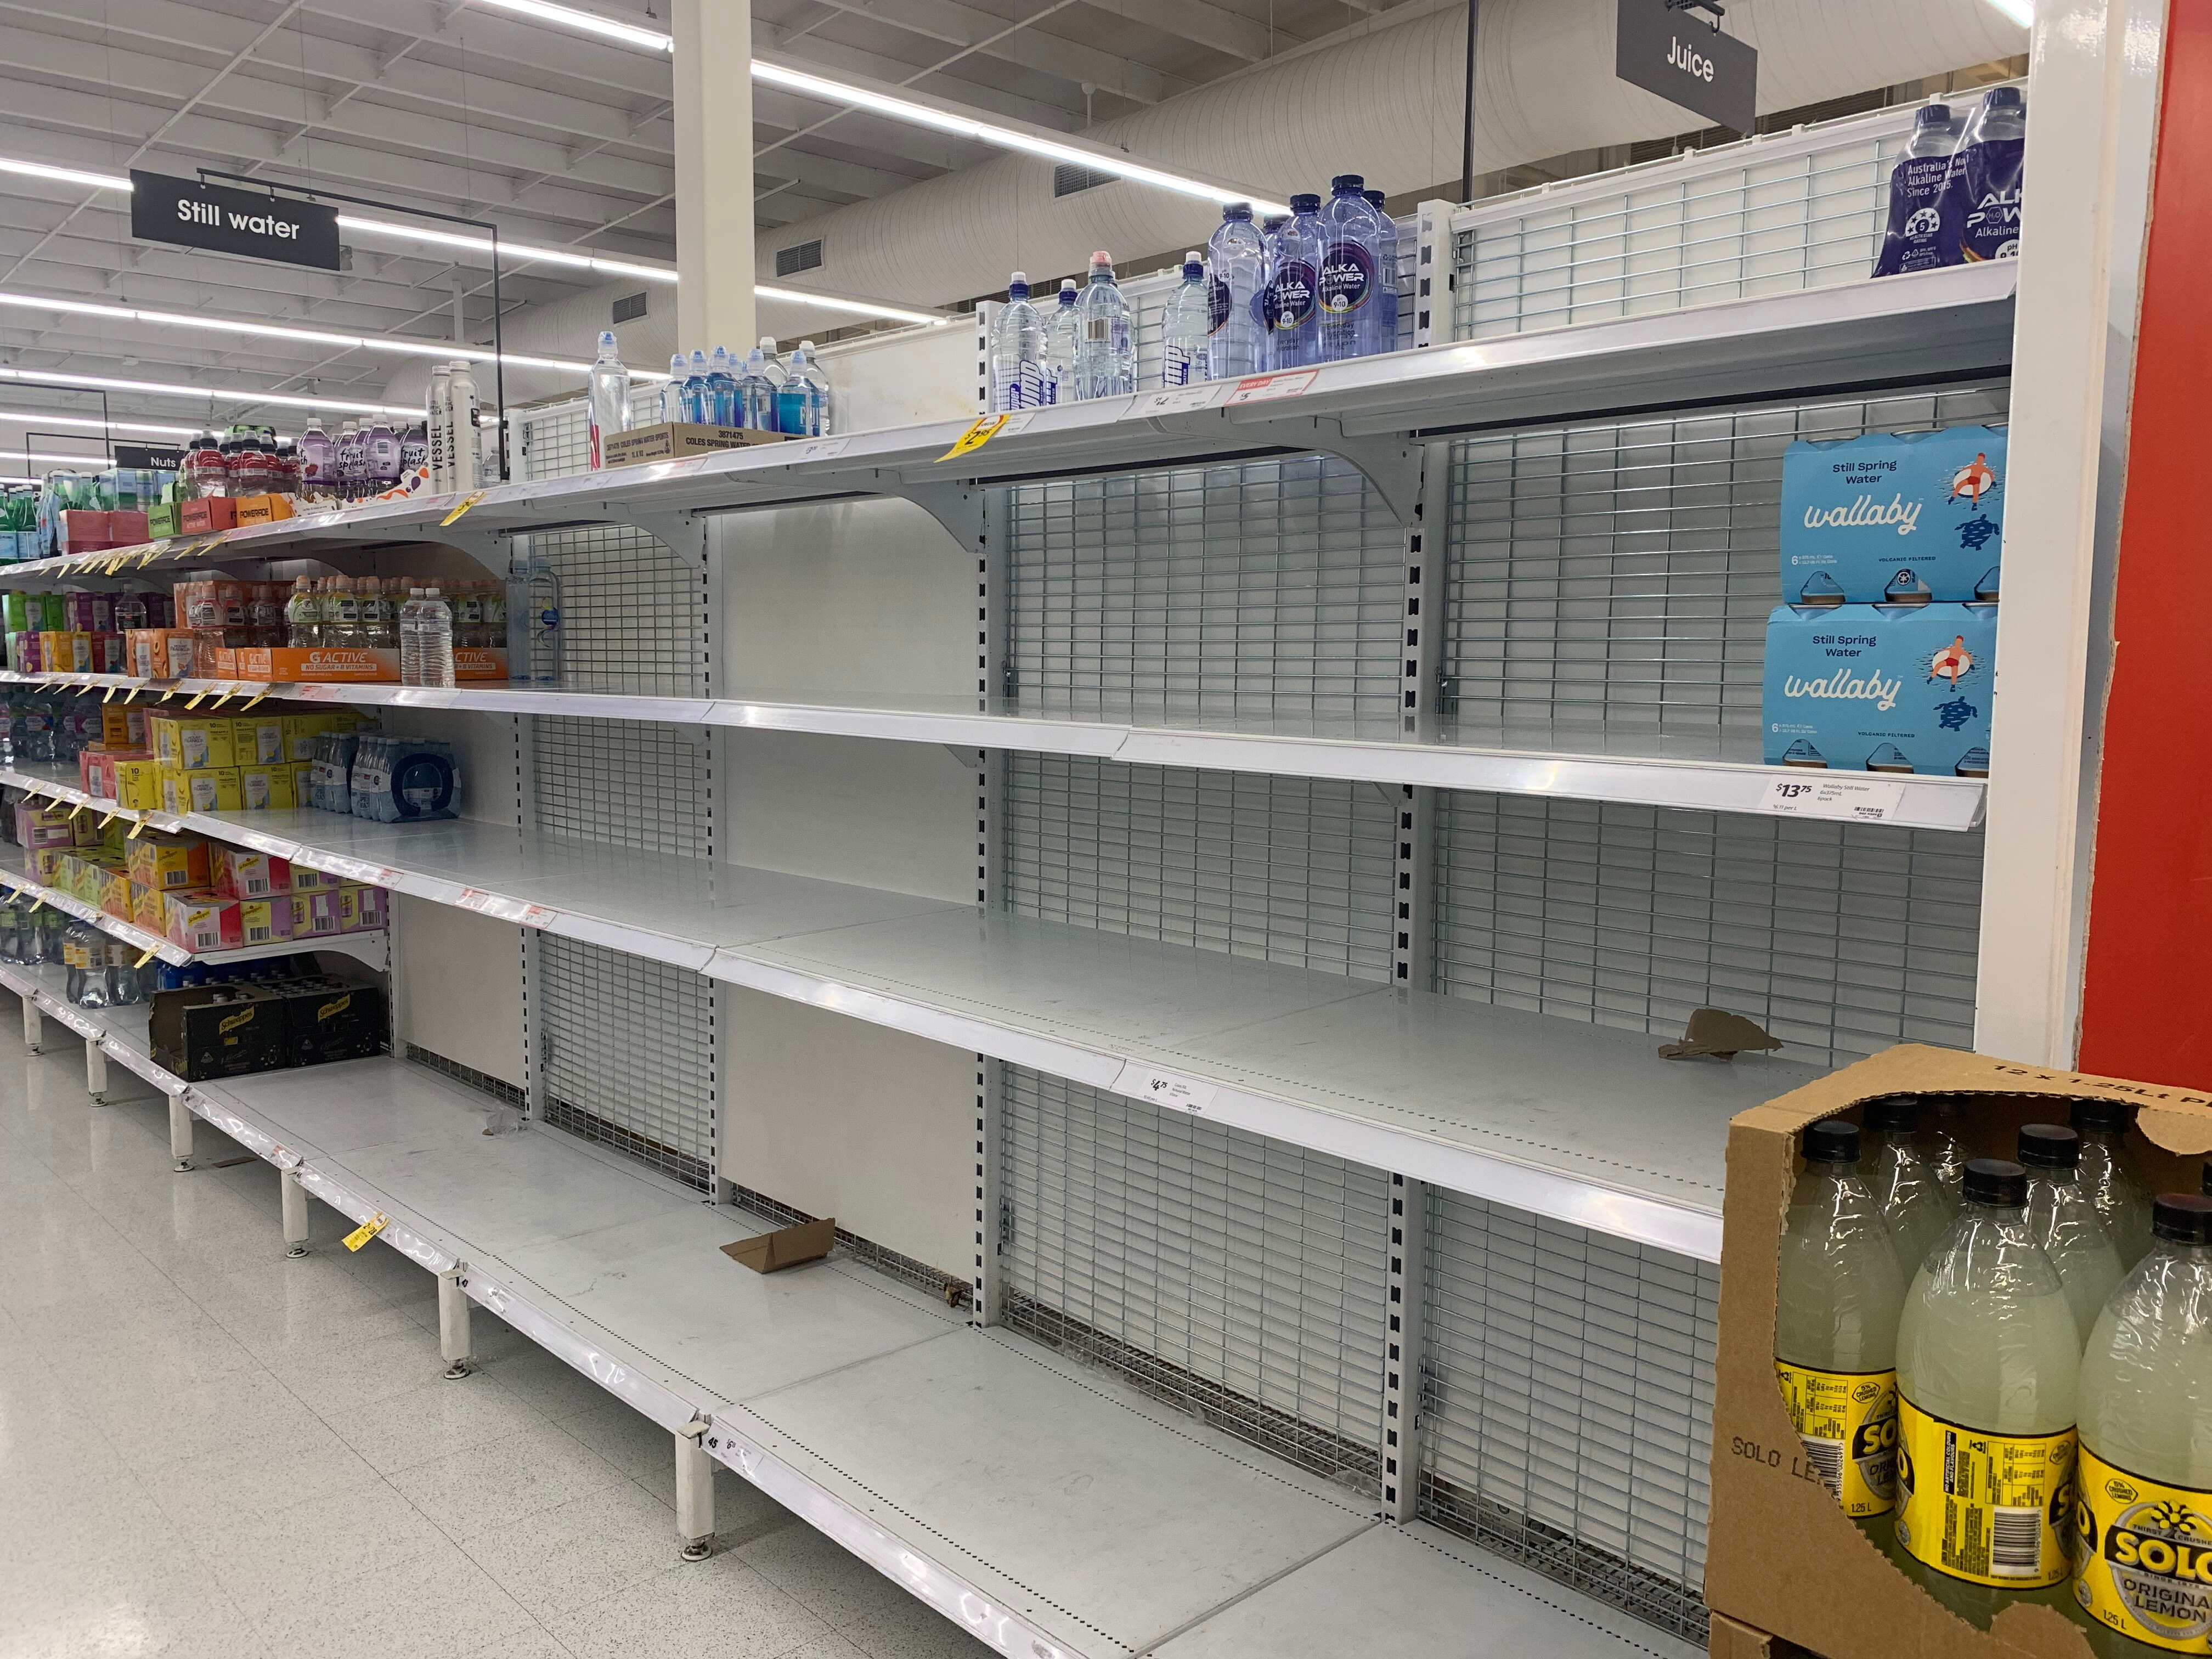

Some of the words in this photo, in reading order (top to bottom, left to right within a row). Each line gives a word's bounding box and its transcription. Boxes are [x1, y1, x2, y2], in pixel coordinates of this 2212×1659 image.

[1667, 36, 1714, 82] Juice
[1908, 171, 1942, 187] Alkaline
[1945, 167, 1967, 179] Water
[1908, 188, 1930, 198] Since
[177, 199, 220, 226] Still
[228, 212, 300, 240] water
[1920, 222, 1926, 231] 5
[1975, 226, 2019, 238] Alkaline
[2007, 244, 2018, 252] pH
[1322, 263, 1359, 275] ALKA
[1275, 281, 1306, 293] ALKA
[1322, 283, 1342, 292] Alkaline
[1327, 322, 1355, 331] Everyday
[620, 439, 631, 448] COLES
[655, 431, 669, 441] SPORTS
[718, 430, 744, 439] 3871475
[431, 425, 442, 471] VESSEL
[446, 421, 455, 468] VESSEL
[686, 437, 706, 446] COLES
[707, 439, 729, 448] SPRING
[150, 457, 176, 467] Nuts
[1832, 462, 1855, 472] Still
[1858, 460, 1897, 471] Spring
[1846, 475, 1882, 484] Water
[183, 511, 207, 523] POWERADE
[240, 507, 269, 518] POWERADE
[1804, 493, 1922, 535] wallaby
[1791, 555, 1798, 566] 6
[1812, 635, 1835, 644] Still
[1837, 635, 1877, 647] Spring
[322, 651, 368, 663] ACTIVE
[454, 652, 488, 662] CTIVE
[1826, 647, 1862, 657] Water
[1784, 668, 1901, 712] wallaby
[1771, 723, 1779, 733] 6
[320, 998, 349, 1018] Schweppes
[221, 1011, 253, 1030] Schweppes
[1994, 1064, 2028, 1076] 12
[2068, 1079, 2171, 1099] 1.25Lt
[1856, 1386, 1877, 1397] CRUSHED
[1859, 1393, 1876, 1402] LEMONS
[1862, 1418, 1897, 1454] SO
[1731, 1436, 1781, 1468] SOLO
[1791, 1457, 1820, 1486] LE
[1945, 1483, 1949, 1492] NO
[2109, 1485, 2133, 1496] CRUSHED
[1850, 1502, 1866, 1513] 1.25
[1867, 1502, 1872, 1512] L
[2132, 1523, 2163, 1536] THIRST
[2178, 1536, 2212, 1546] CRUSHE
[2124, 1578, 2212, 1611] ORIGINA
[2134, 1595, 2207, 1623] LEMON
[2121, 1618, 2127, 1630] L
